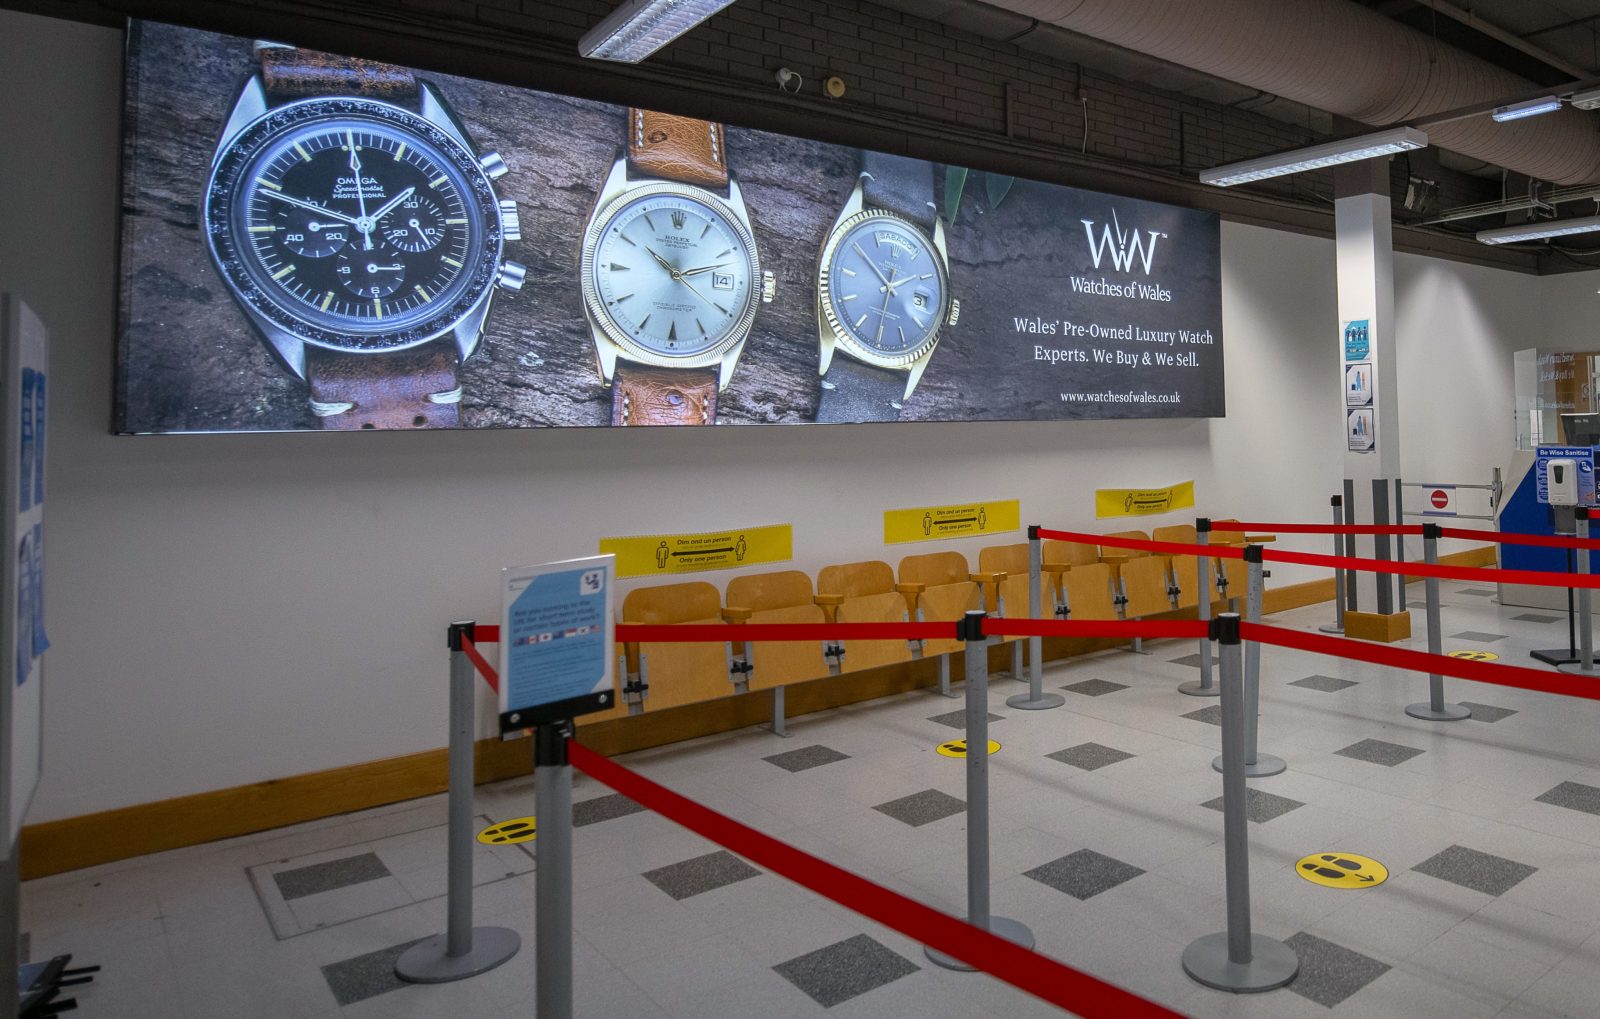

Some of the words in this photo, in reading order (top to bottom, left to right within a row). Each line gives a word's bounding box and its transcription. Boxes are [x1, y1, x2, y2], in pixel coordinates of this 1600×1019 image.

[403, 201, 419, 209] 30
[325, 232, 342, 240] 20
[394, 229, 408, 237] 20
[286, 234, 304, 242] 40
[665, 235, 690, 243] ROLEX
[716, 276, 729, 286] 14
[371, 286, 380, 294] 6
[1070, 276, 1122, 298] Watches
[1124, 282, 1136, 299] of
[1138, 284, 1171, 302] Wales
[1064, 321, 1132, 340] Pre-Owned
[1136, 327, 1175, 346] Luxury
[1179, 330, 1213, 344] Watch
[1034, 345, 1089, 364] Experts.
[1093, 349, 1113, 364] We
[1116, 351, 1138, 368] Buy
[1142, 352, 1152, 366] &
[1155, 352, 1173, 366] We
[1176, 352, 1199, 367] Sell.
[1060, 391, 1181, 403] www.watchesofwales.co.uk
[706, 554, 726, 562] person
